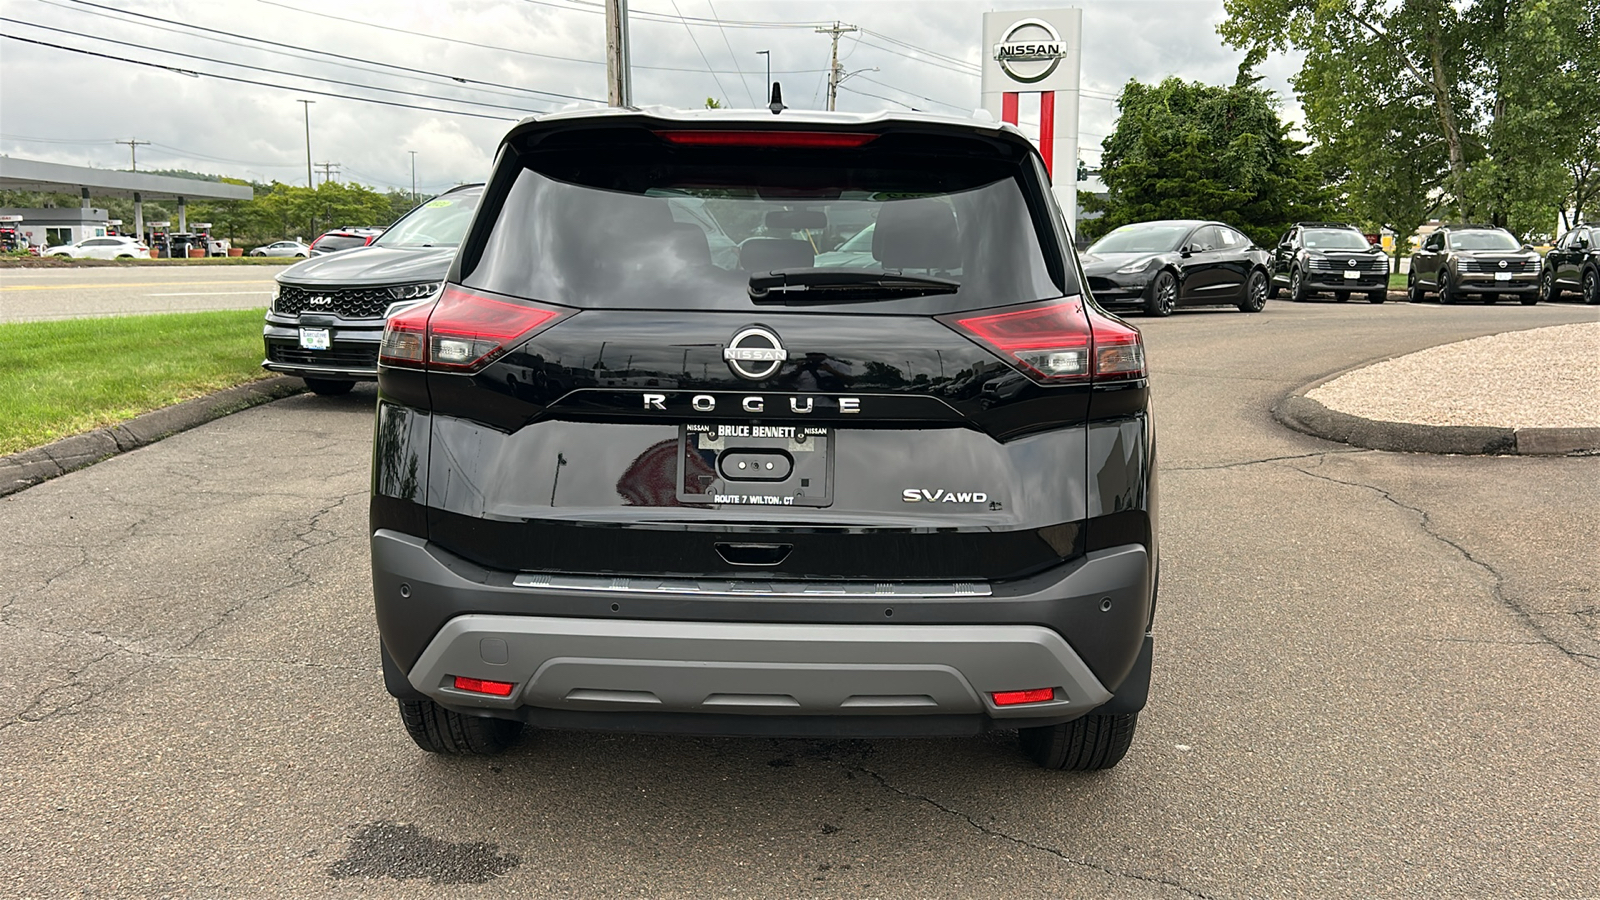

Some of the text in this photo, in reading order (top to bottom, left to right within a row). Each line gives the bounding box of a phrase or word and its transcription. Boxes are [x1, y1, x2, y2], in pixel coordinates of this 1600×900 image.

[1000, 44, 1059, 56] NISSAN
[725, 350, 786, 360] NISSAN
[643, 394, 860, 413] ROGUE
[686, 424, 710, 432] NISSAN
[717, 425, 796, 438] BRUCE BENNETT
[804, 427, 827, 435] NISSAN
[714, 494, 740, 504] ROUTE
[741, 495, 748, 504] 7
[783, 496, 794, 505] CT
[902, 488, 988, 503] SV AWD
